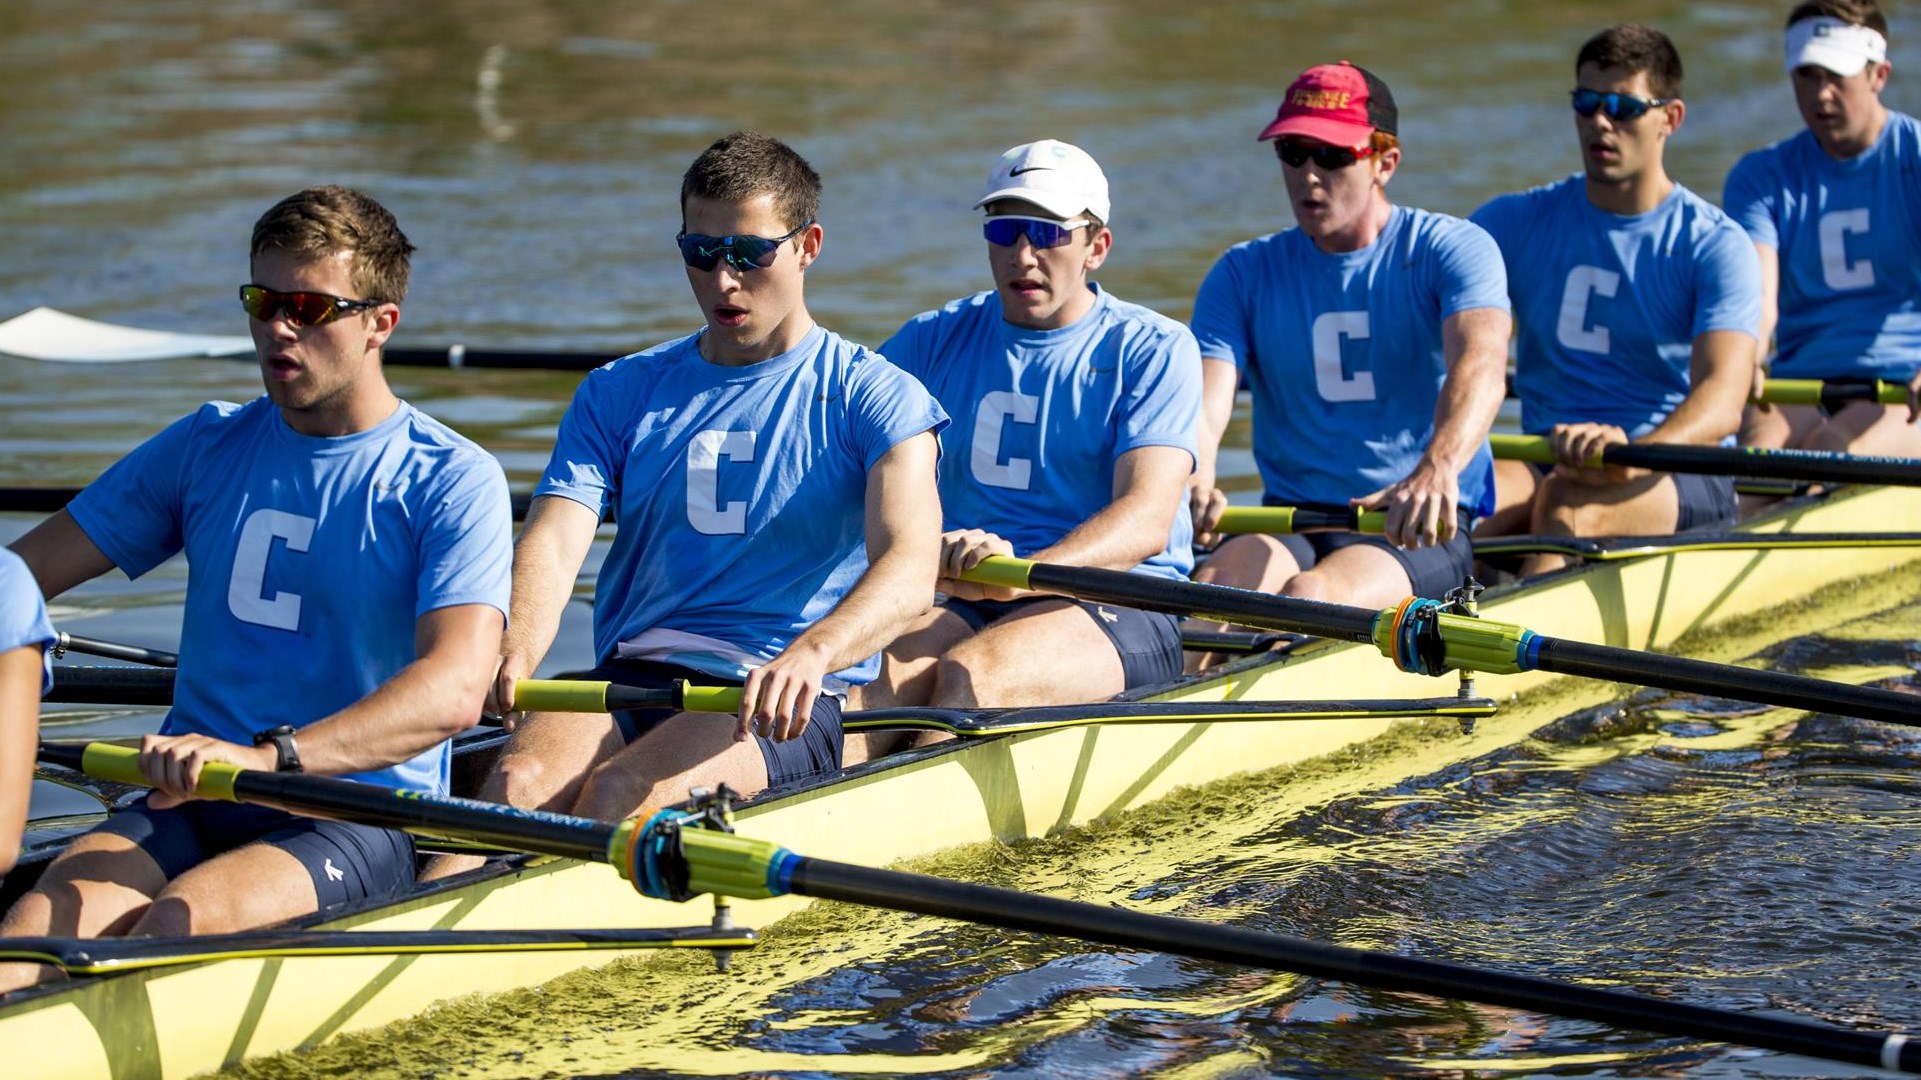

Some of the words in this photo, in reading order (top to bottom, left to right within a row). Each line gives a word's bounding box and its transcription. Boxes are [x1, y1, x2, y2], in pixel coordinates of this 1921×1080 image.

[1819, 208, 1875, 291] C
[1312, 311, 1376, 402] C
[1557, 265, 1620, 354] C
[687, 430, 757, 535] C
[971, 391, 1039, 490] C
[228, 508, 315, 631] C
